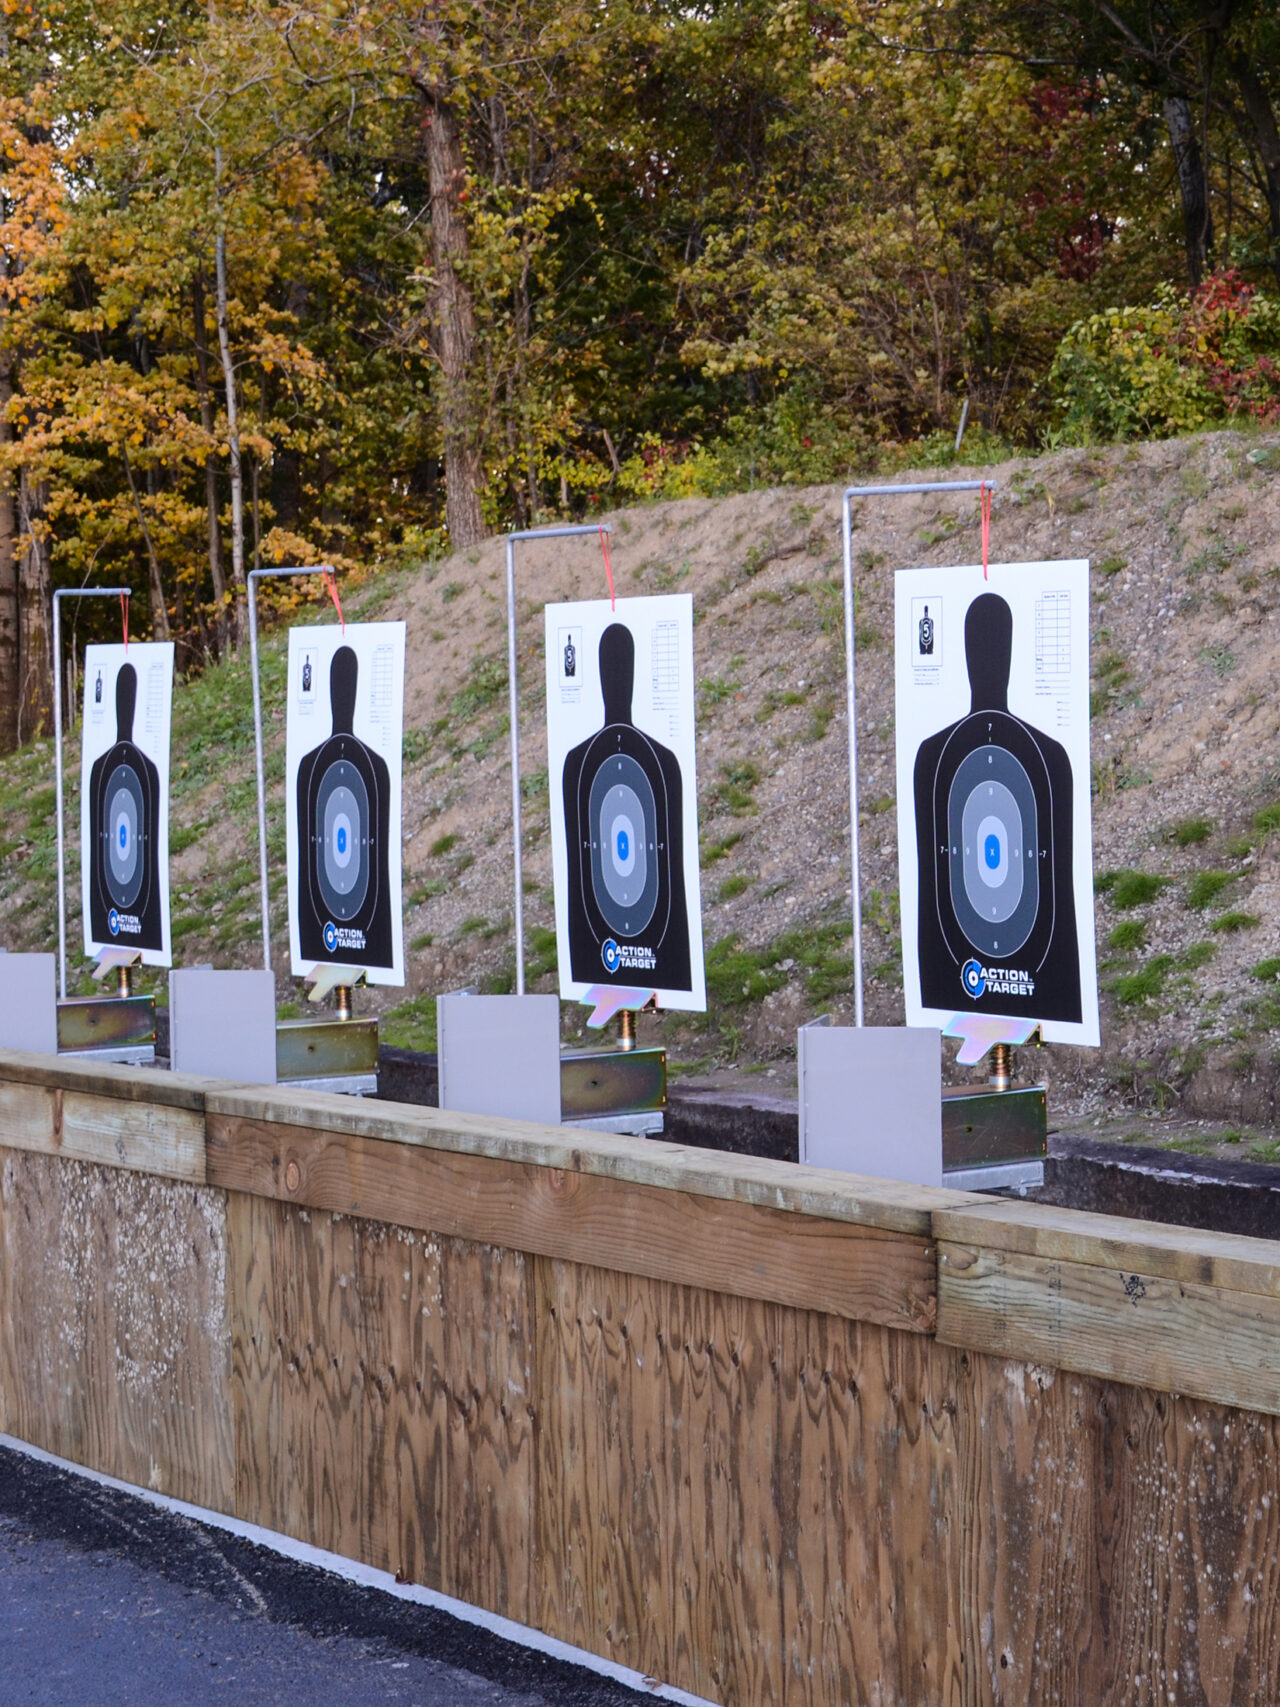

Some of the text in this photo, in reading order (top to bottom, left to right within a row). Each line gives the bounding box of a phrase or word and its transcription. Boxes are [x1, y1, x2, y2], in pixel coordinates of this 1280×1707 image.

[334, 928, 363, 939] ACTION
[338, 939, 367, 950] TARGET
[615, 945, 652, 957] ACTION
[620, 957, 656, 969] TARGET
[980, 967, 1029, 982] ACTION
[986, 982, 1035, 996] TARGET
